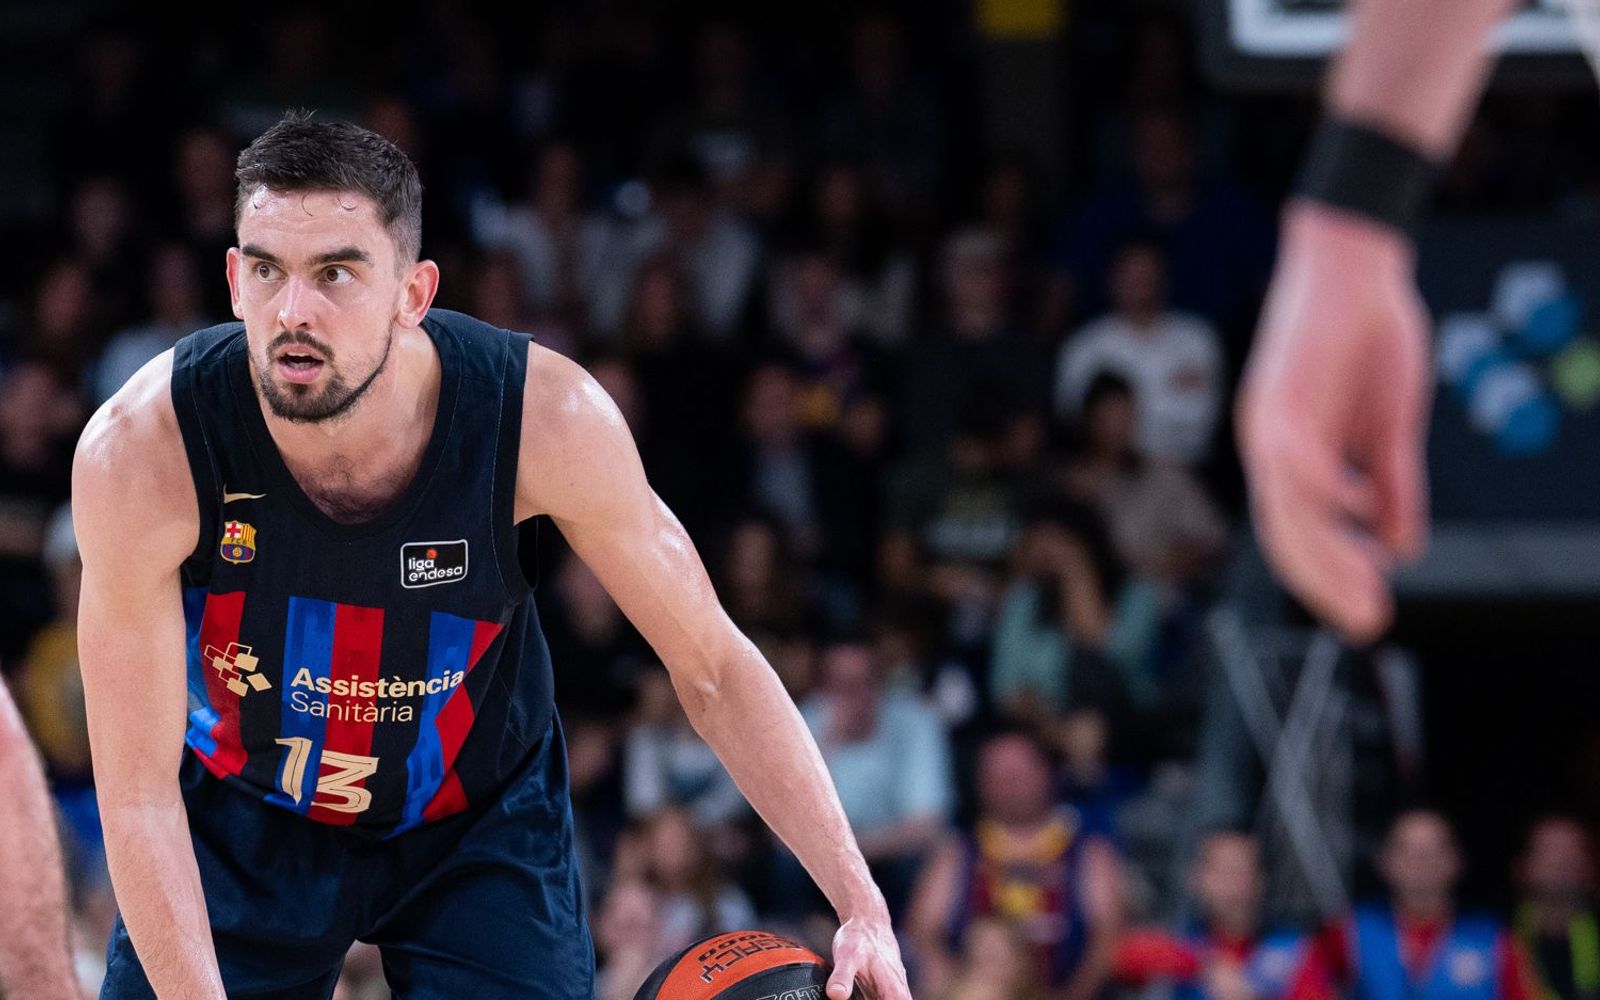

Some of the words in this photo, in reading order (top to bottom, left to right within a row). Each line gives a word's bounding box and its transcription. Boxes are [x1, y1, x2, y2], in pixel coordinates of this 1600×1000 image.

[408, 557, 435, 571] liga
[408, 566, 463, 582] endesa
[290, 667, 465, 698] Assistència
[290, 691, 414, 723] Sanitària
[274, 736, 380, 814] 13
